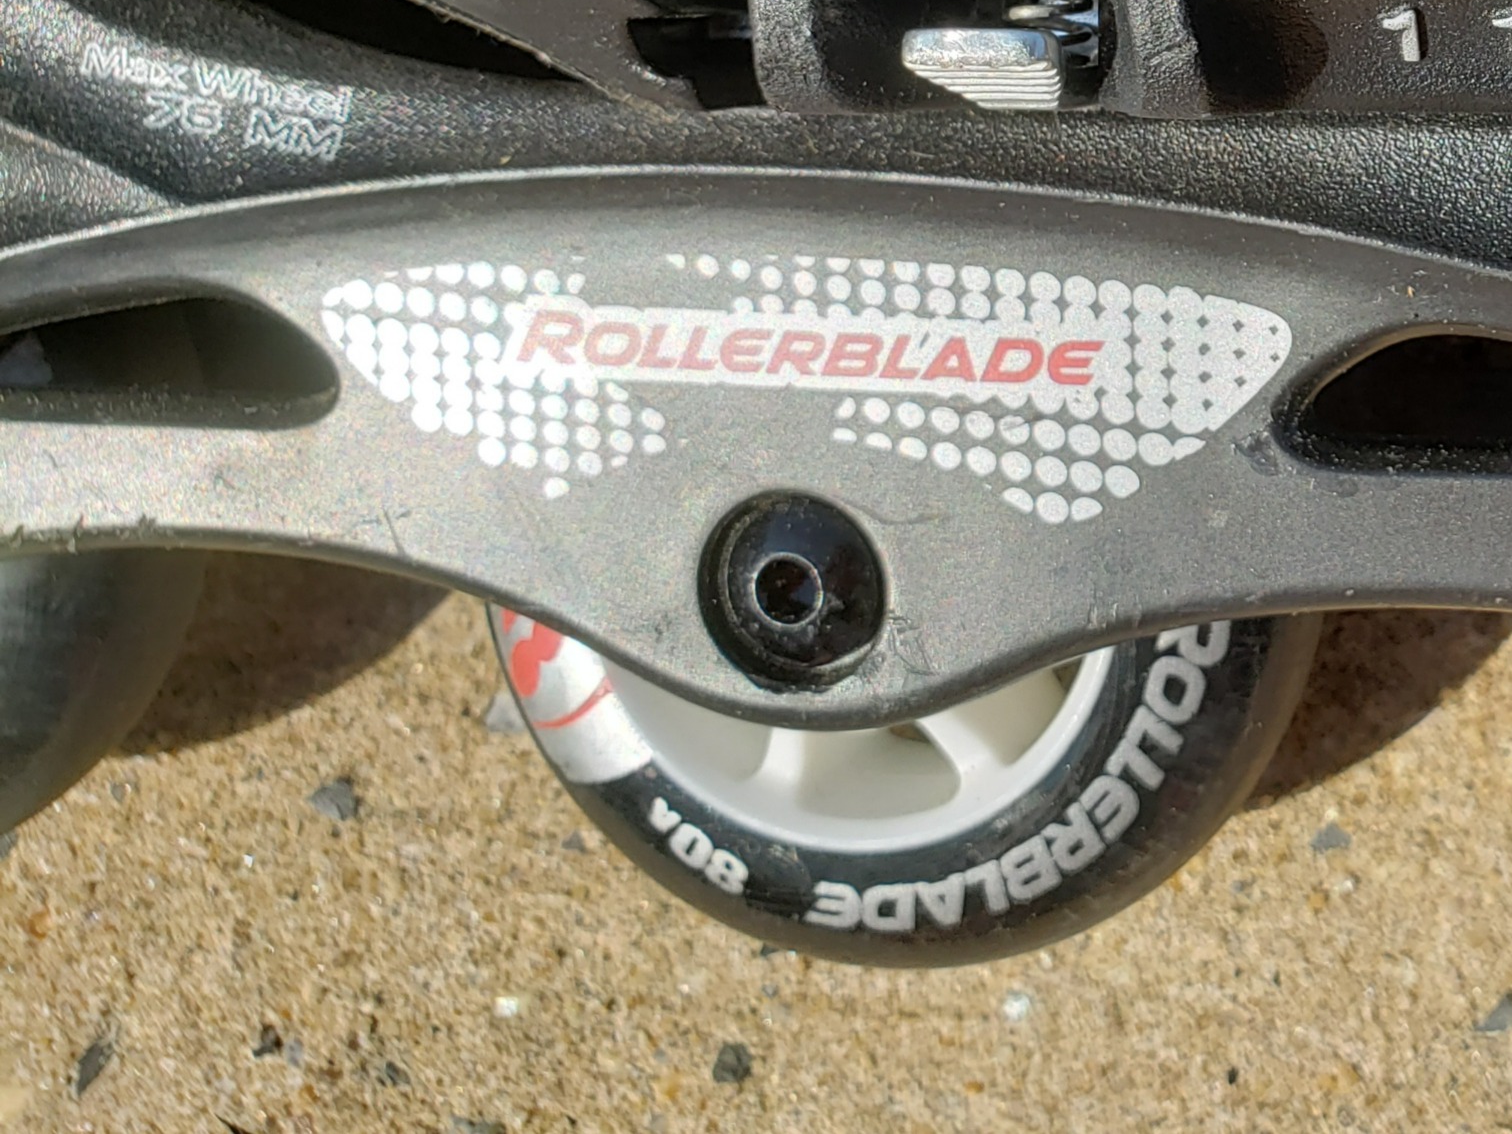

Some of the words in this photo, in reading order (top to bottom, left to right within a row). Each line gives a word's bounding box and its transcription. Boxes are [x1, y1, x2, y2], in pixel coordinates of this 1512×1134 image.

[1380, 8, 1421, 62] 1
[245, 108, 344, 162] MM
[517, 310, 1105, 387] ROLLERBLADE
[646, 796, 750, 895] 80A
